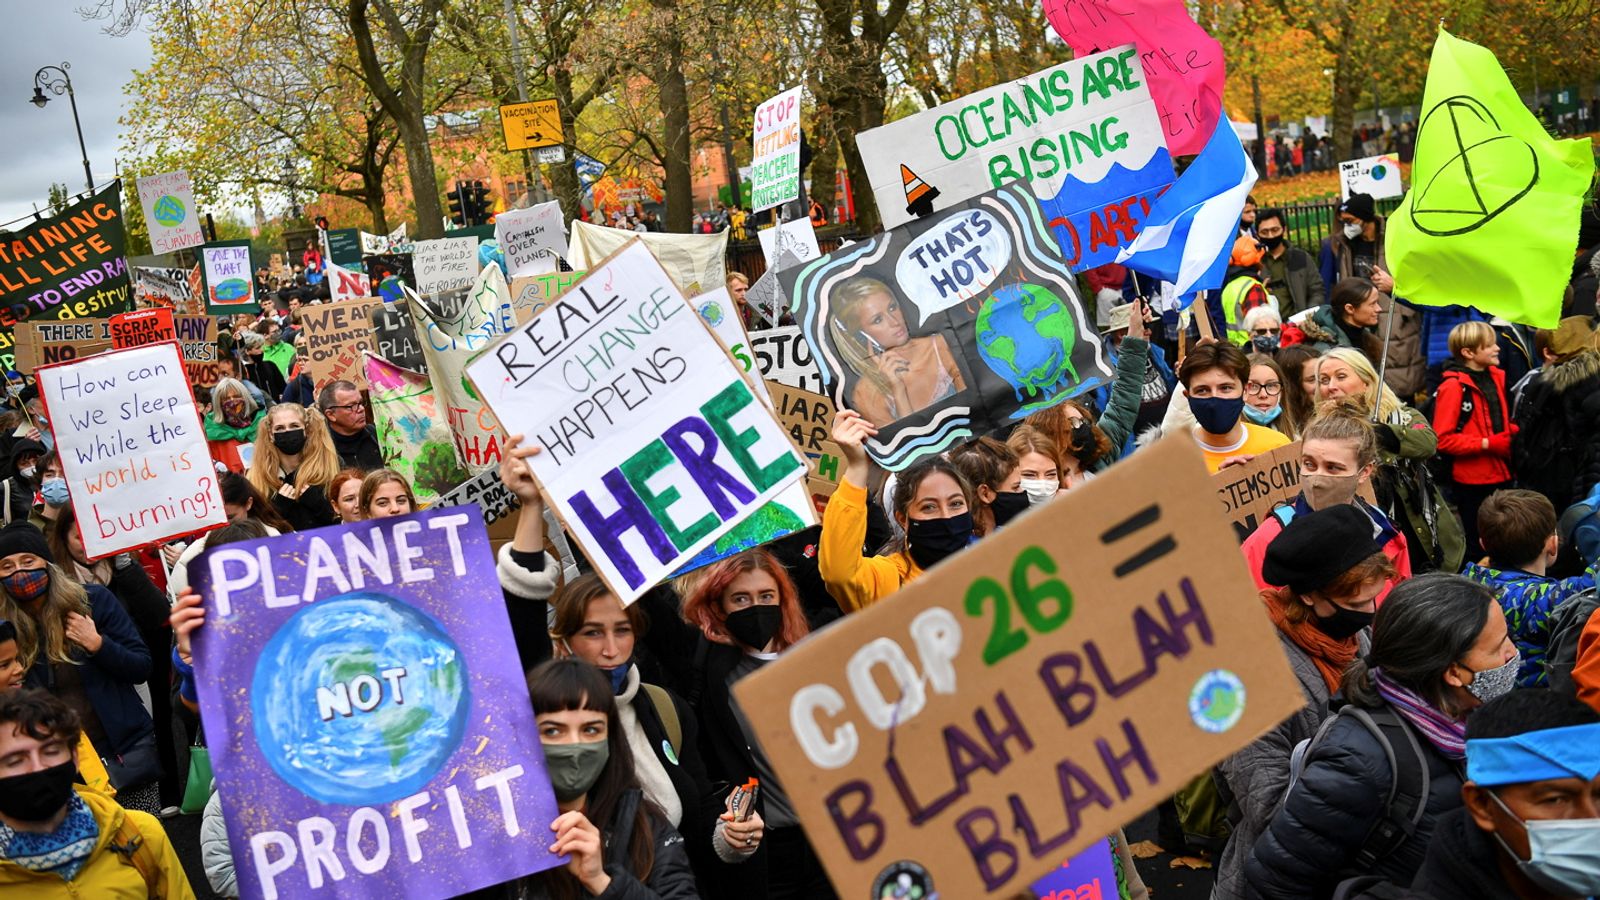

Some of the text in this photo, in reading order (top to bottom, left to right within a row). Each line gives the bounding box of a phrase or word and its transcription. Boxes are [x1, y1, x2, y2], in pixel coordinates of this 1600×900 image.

[503, 104, 556, 118] VACCINATION
[756, 95, 795, 132] STOP
[934, 48, 1141, 161] OCEANS ARE
[524, 119, 541, 128] SITE
[754, 122, 799, 158] KETTLING
[753, 151, 799, 188] PEACEFUL
[987, 116, 1129, 189] RISING
[753, 175, 799, 211] PROTESTERS
[155, 231, 202, 251] SURVIVE
[505, 225, 545, 243] CAPITALISM
[909, 209, 993, 269] THAT'S
[1089, 195, 1140, 253] ARE
[41, 233, 113, 276] LIFE
[207, 248, 248, 261] SAVE THE
[420, 255, 436, 264] THE
[440, 250, 473, 262] WORLDS
[444, 240, 468, 250] LIAR
[508, 237, 538, 256] OVER
[514, 248, 552, 268] PLANET
[214, 262, 242, 276] PLANET
[423, 262, 469, 276] ON FIRE.
[930, 245, 992, 299] HOT
[27, 289, 62, 311] TO
[60, 268, 105, 298] END
[37, 324, 96, 342] THERE
[112, 317, 159, 336] SCRAP
[115, 328, 173, 348] TRIDENT
[302, 308, 349, 334] WE
[495, 285, 620, 382] REAL
[562, 286, 687, 393] CHANGE
[44, 345, 77, 365] NO
[312, 344, 343, 362] OUT
[60, 363, 168, 401] How can
[186, 363, 219, 384] HAOS
[69, 393, 179, 432] we sleep
[536, 346, 688, 466] HAPPENS
[75, 422, 187, 465] while the
[84, 452, 193, 496] world is
[567, 378, 802, 592] HERE
[92, 477, 217, 540] burning?
[208, 513, 470, 617] PLANET
[316, 667, 407, 721] NOT
[823, 576, 1215, 862] BLAH BLAH
[954, 718, 1160, 893] BLAH
[249, 764, 525, 900] PROFIT
